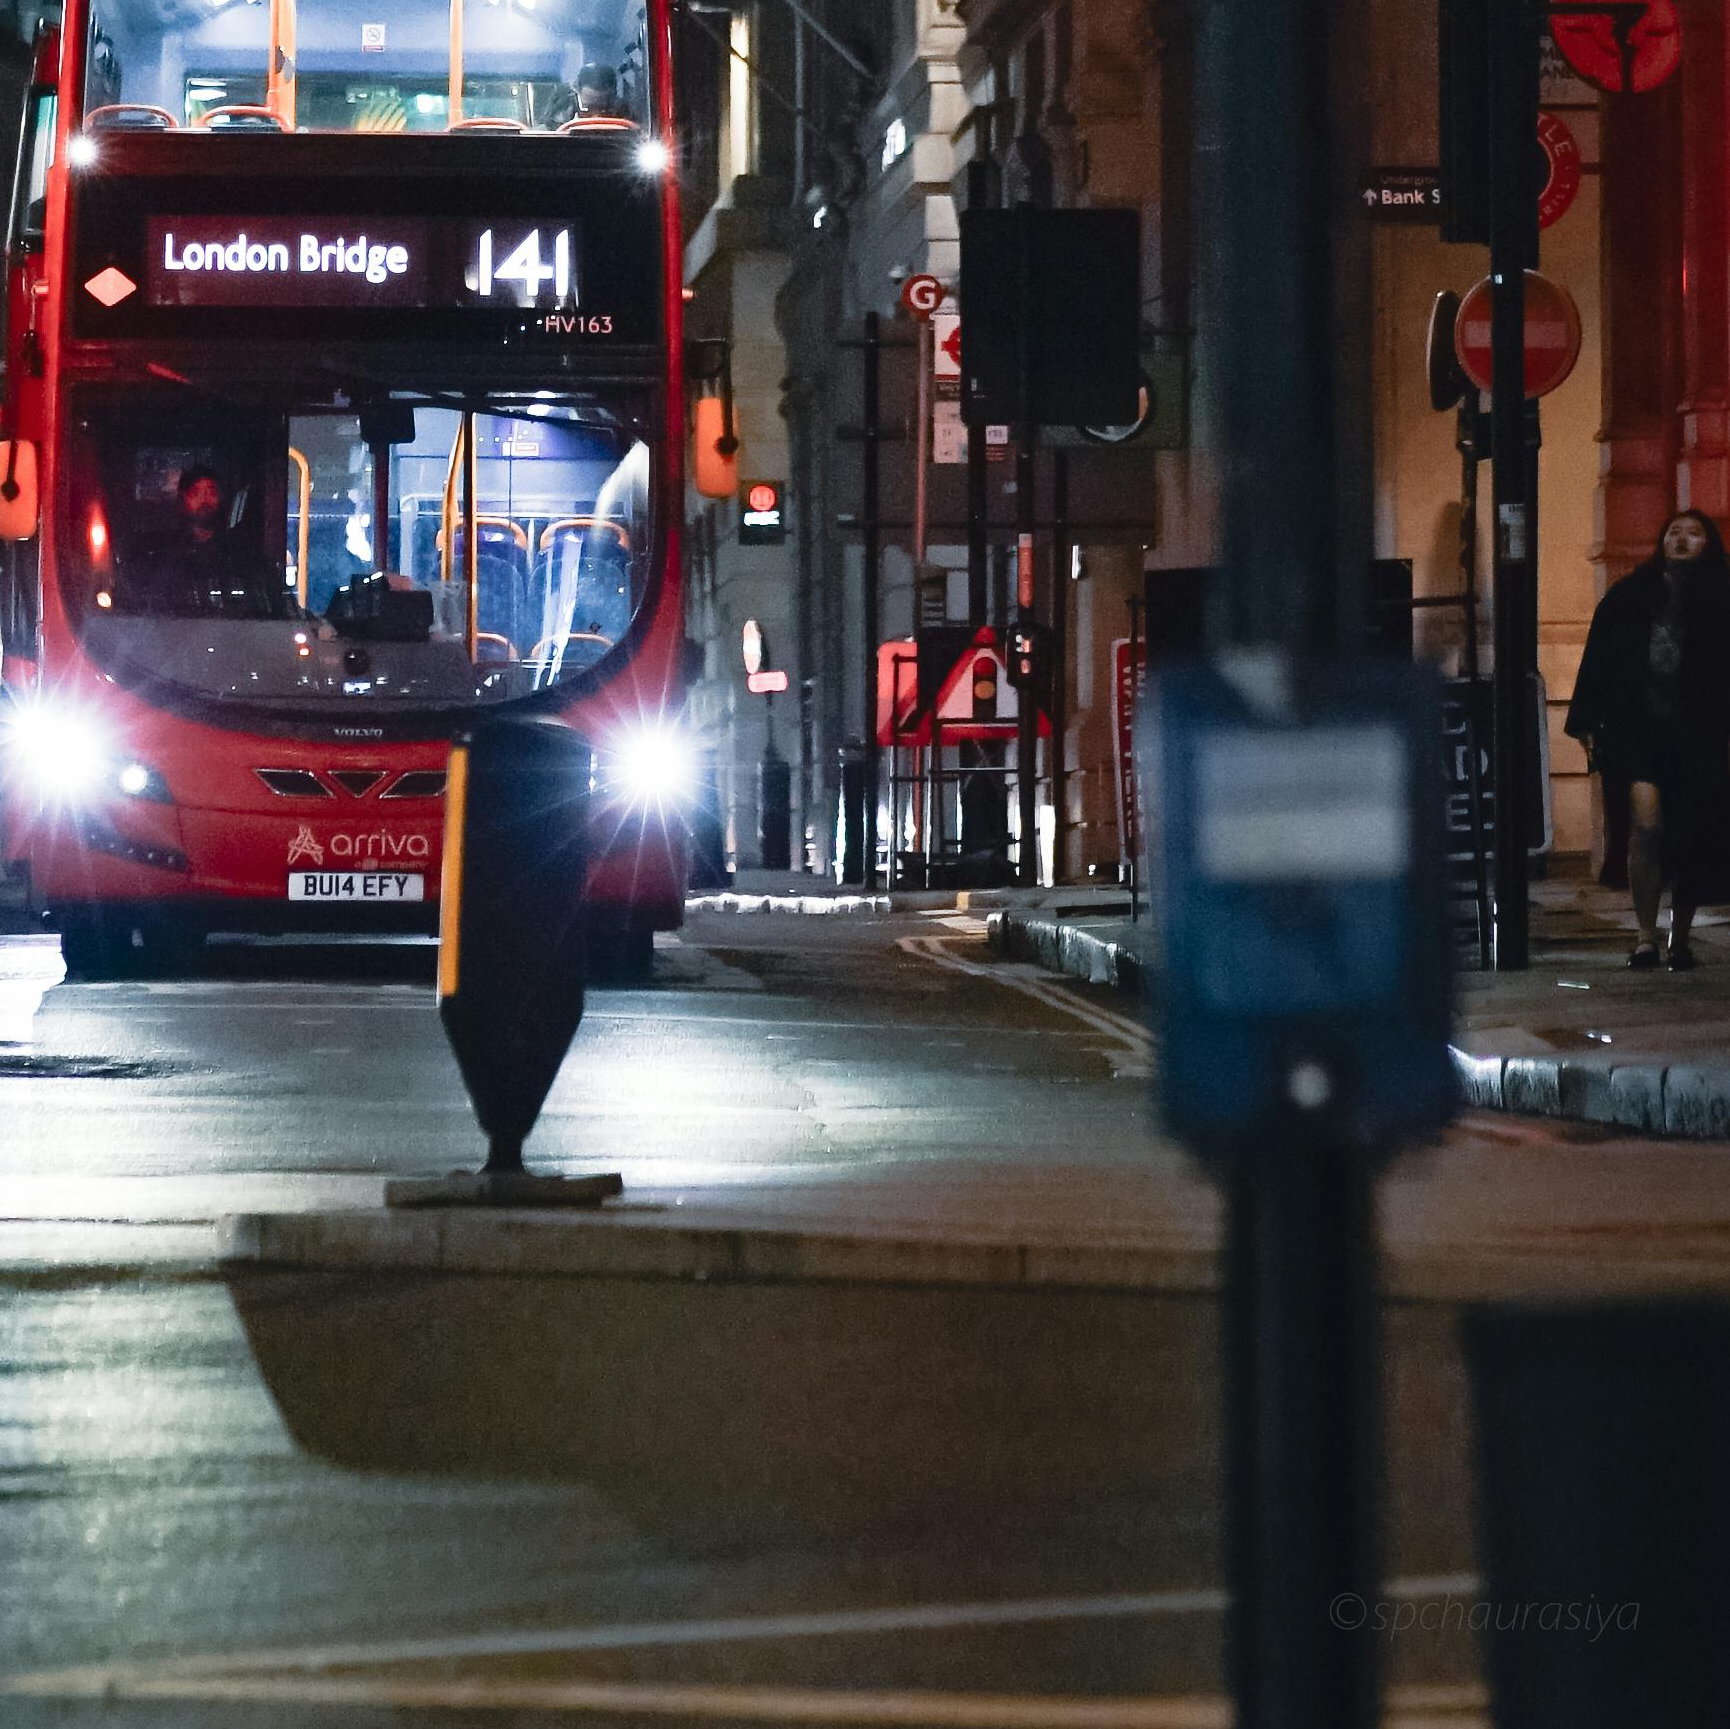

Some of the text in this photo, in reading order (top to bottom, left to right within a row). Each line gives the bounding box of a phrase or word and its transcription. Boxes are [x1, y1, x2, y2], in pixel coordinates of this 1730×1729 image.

[1381, 189, 1425, 205] Bank
[164, 233, 409, 284] London Bridge
[478, 228, 570, 297] 141
[909, 280, 936, 310] G
[545, 315, 614, 334] HV163
[334, 728, 383, 737] VOLVO
[330, 829, 430, 856] arriva
[304, 875, 408, 896] BU14 EFY
